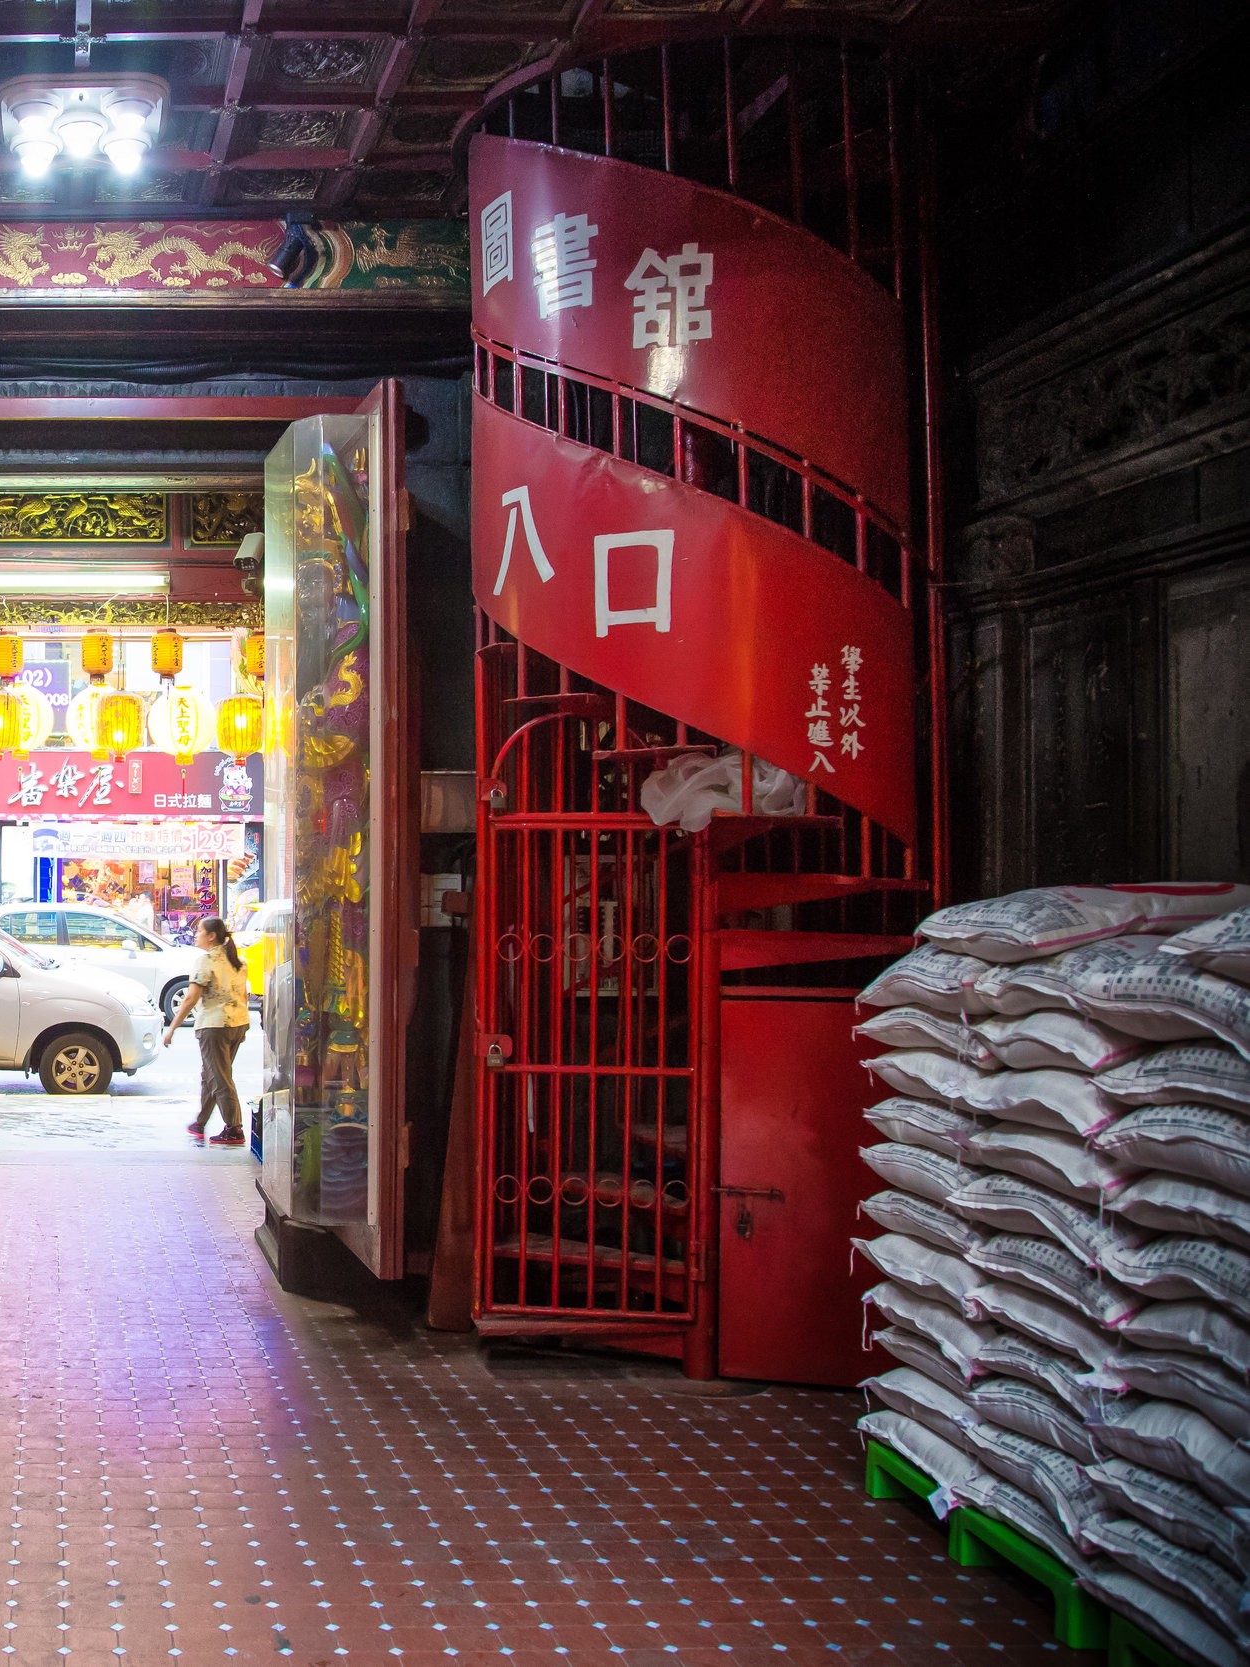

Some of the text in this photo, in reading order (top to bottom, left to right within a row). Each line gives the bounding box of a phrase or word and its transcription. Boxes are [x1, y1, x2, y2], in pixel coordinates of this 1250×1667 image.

[492, 485, 675, 638] 入口
[176, 697, 193, 746] 天上聖母
[804, 662, 836, 773] 禁止進入
[839, 645, 866, 760] 學生以外
[131, 762, 140, 792] ラーメン
[154, 793, 212, 808] 日式拉麵
[191, 830, 225, 851] 129
[200, 859, 213, 918] 加麵不加
